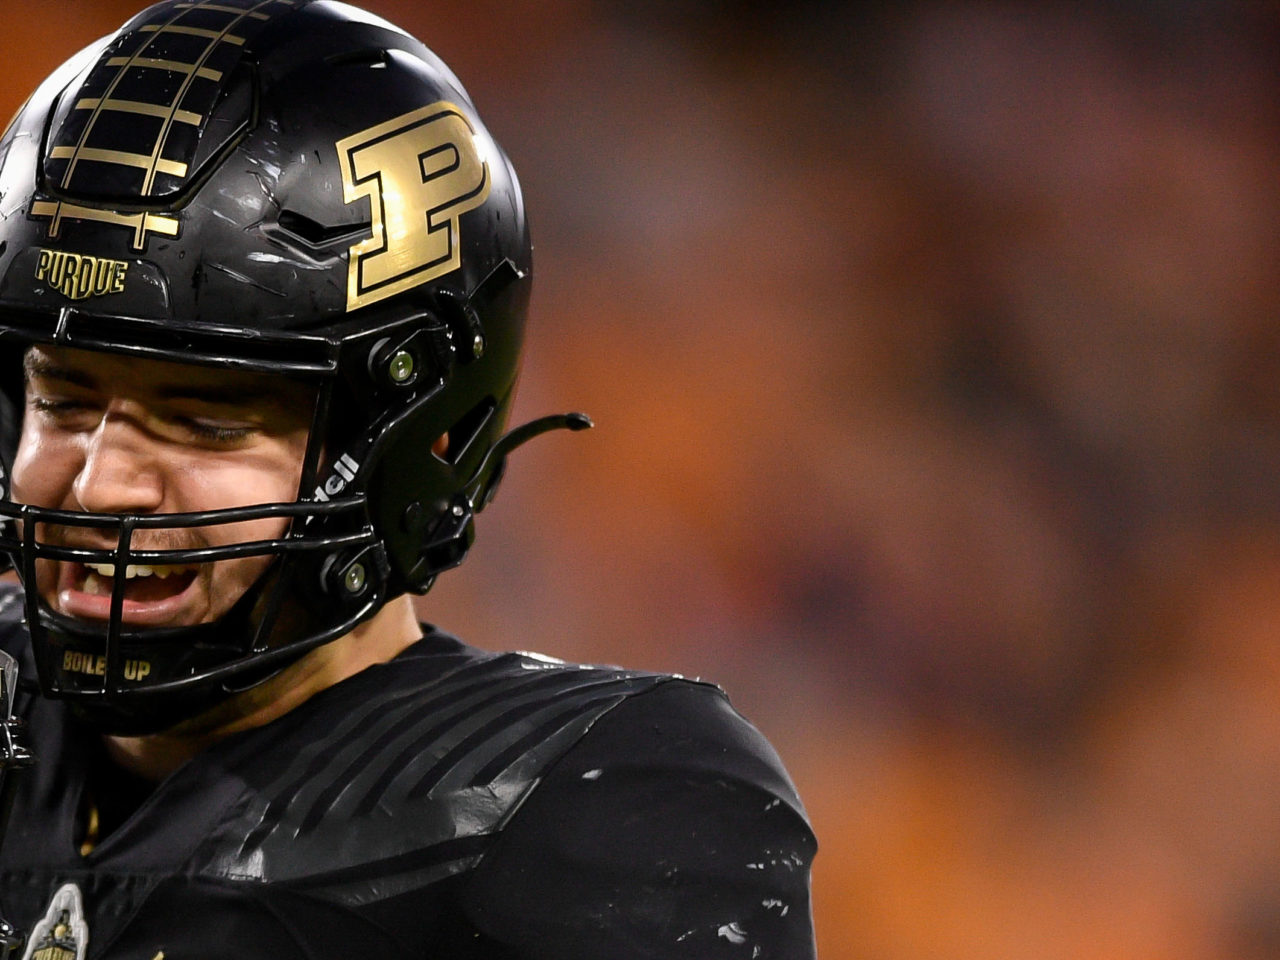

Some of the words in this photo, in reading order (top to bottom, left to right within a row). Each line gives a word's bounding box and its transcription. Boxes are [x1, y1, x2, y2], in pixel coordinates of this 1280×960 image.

[336, 101, 492, 312] P
[35, 249, 128, 300] PURDUE
[63, 650, 107, 676] BOILE
[124, 659, 151, 681] UP
